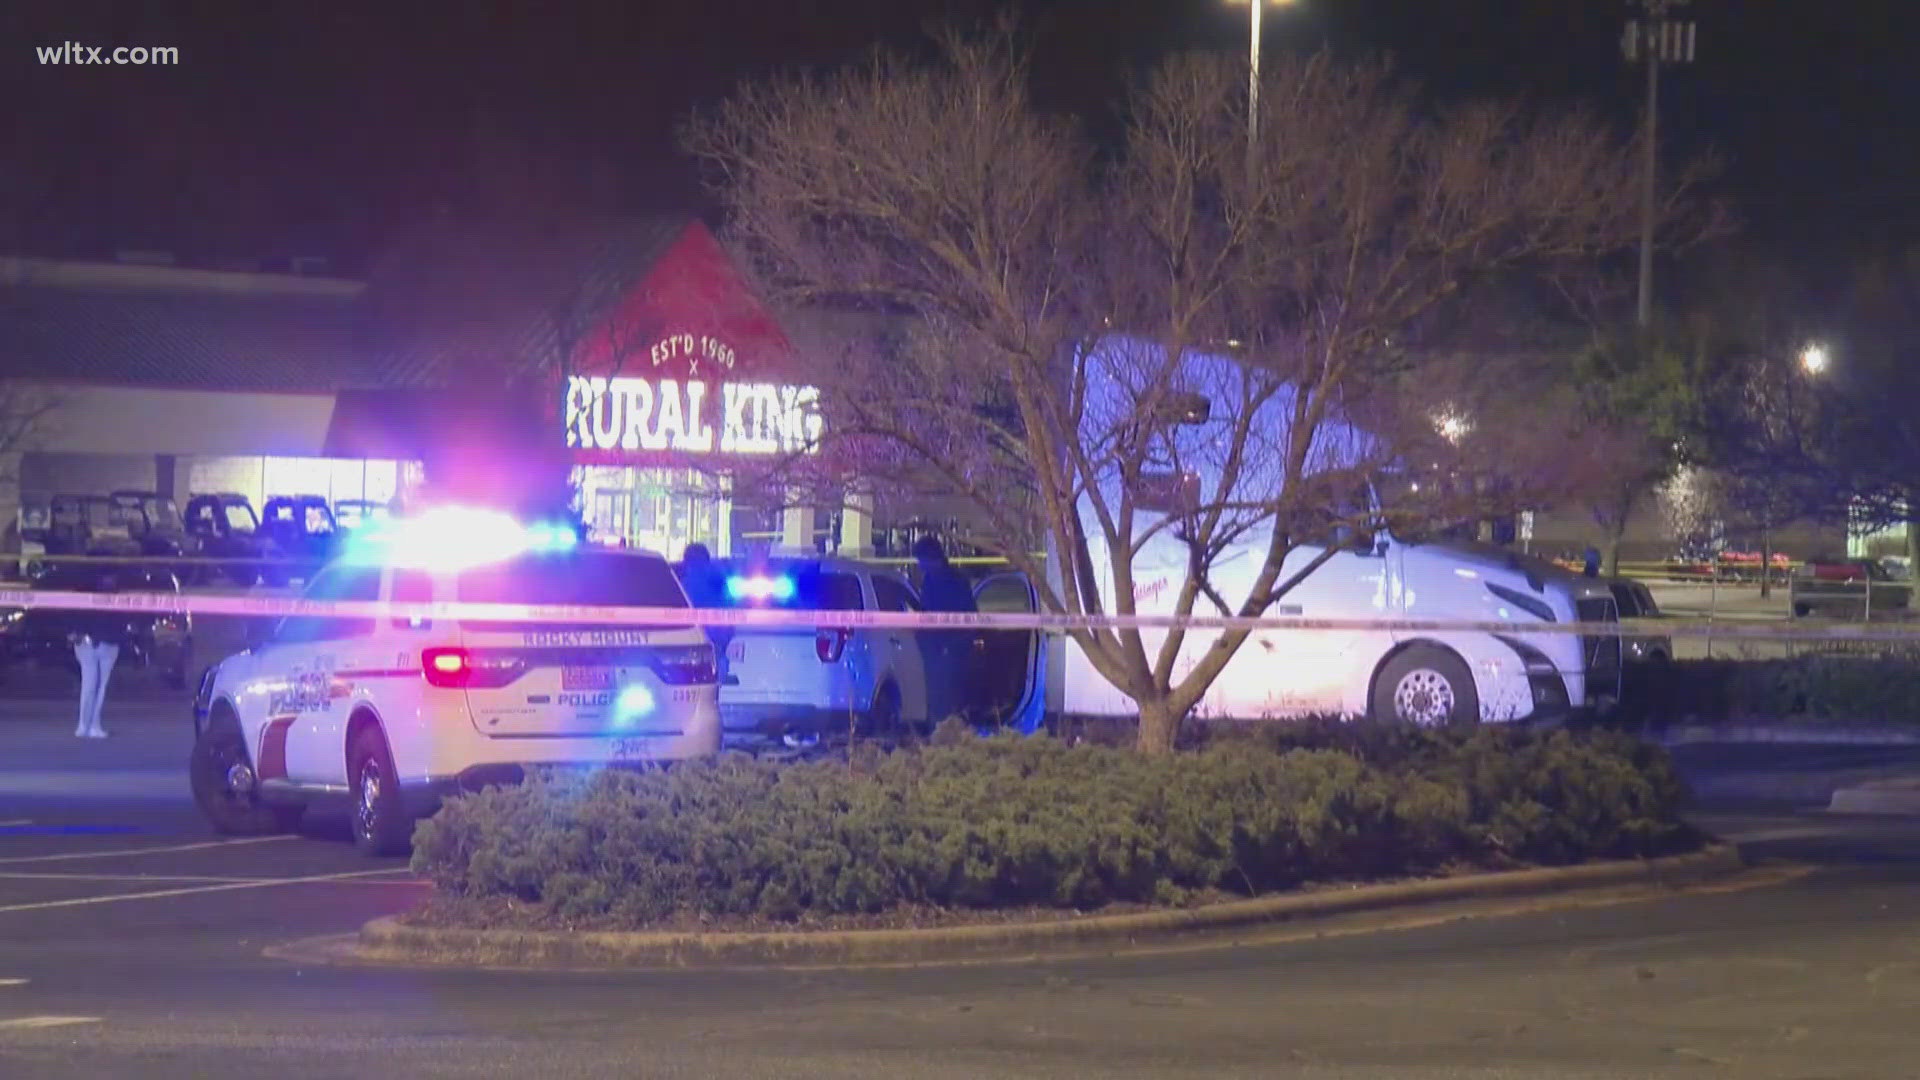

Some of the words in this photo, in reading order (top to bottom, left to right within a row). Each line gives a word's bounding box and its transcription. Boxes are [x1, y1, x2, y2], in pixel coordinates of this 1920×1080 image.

[650, 334, 694, 367] EST'D
[700, 335, 735, 369] 1960
[565, 374, 713, 451] RURAL
[720, 382, 823, 455] KING
[523, 632, 584, 648] ROCKY
